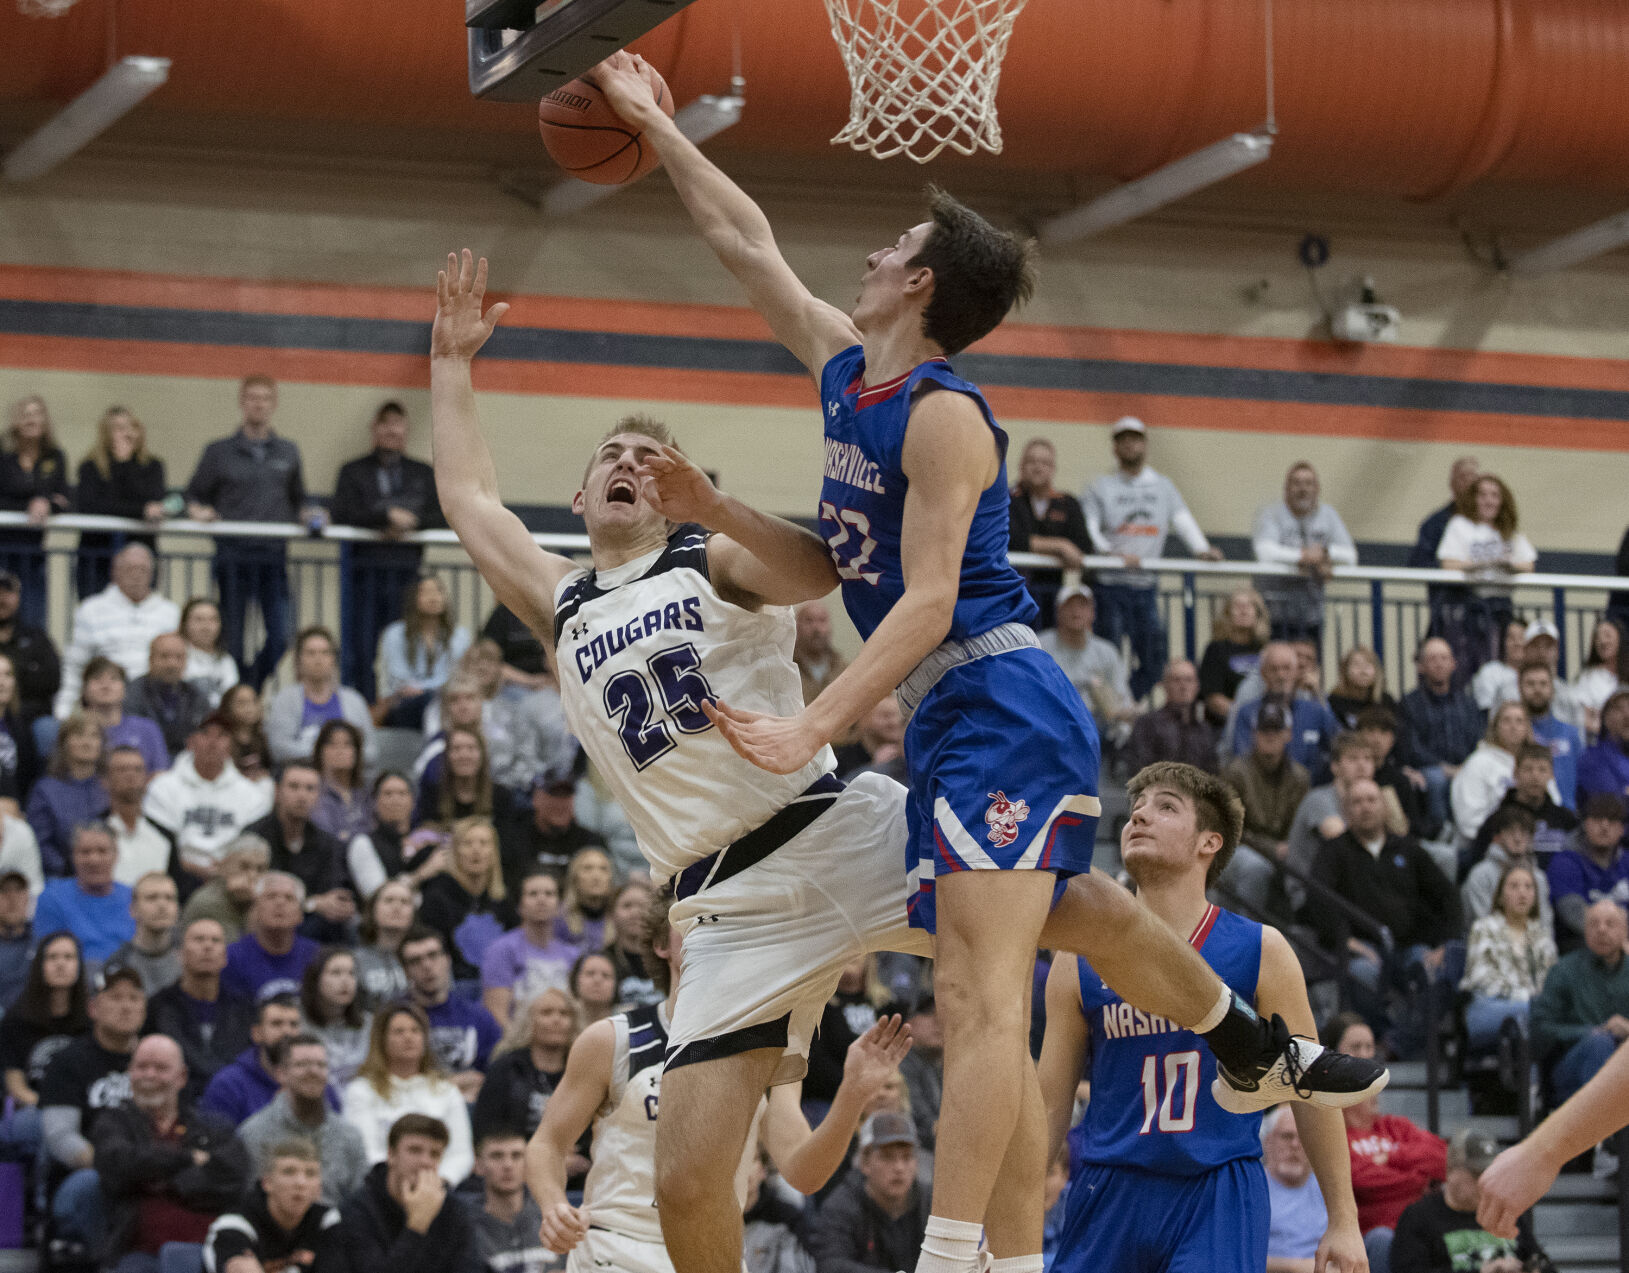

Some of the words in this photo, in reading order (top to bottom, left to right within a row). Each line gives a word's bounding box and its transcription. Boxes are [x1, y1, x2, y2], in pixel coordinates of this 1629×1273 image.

[821, 501, 886, 587] 22
[575, 596, 705, 685] COUGARS
[603, 642, 720, 773] 25
[644, 1094, 659, 1121] C
[1139, 1050, 1201, 1136] 10
